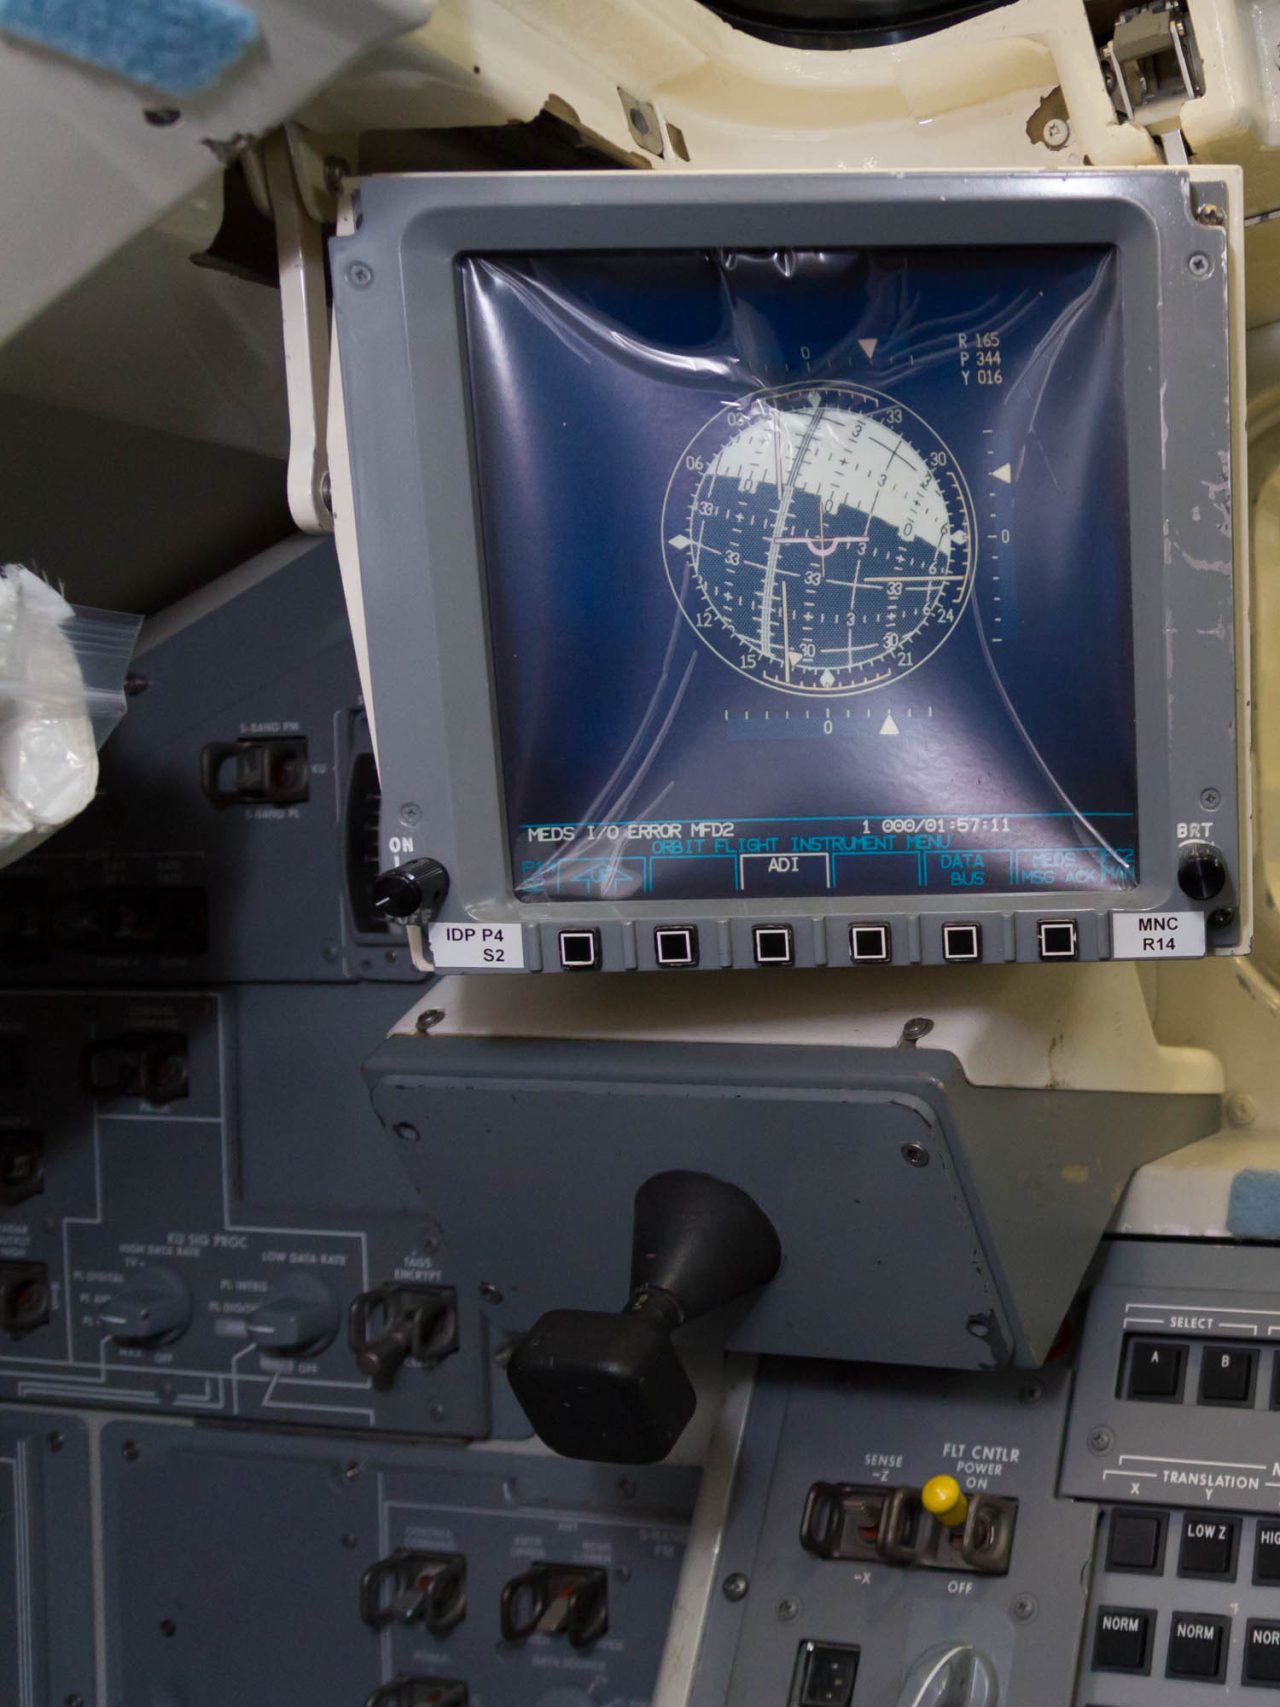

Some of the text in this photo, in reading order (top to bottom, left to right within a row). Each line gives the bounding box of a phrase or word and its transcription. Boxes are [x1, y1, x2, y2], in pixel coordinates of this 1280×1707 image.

[958, 333, 1000, 348] R 165
[960, 352, 1001, 367] P 344
[962, 370, 1003, 386] Y 016
[887, 409, 904, 424] 33
[686, 456, 704, 471] 06
[930, 452, 948, 467] 30
[1001, 529, 1010, 543] 0
[804, 571, 821, 586] 33
[696, 612, 712, 627] 12
[937, 607, 954, 624] 24
[740, 654, 757, 669] 15
[898, 651, 914, 667] 21
[823, 719, 833, 734] 0
[528, 822, 735, 842] MEDS I/O ERROR MFD2
[862, 820, 871, 834] 1
[1176, 822, 1214, 839] BRT
[388, 836, 414, 853] ON
[651, 833, 952, 855] ORBIT FLIGHT INSTRUMENT MENU
[768, 857, 799, 872] ADI
[940, 854, 984, 869] DATA
[950, 871, 984, 887] BUS
[1022, 869, 1056, 884] MSG
[1138, 917, 1179, 932] MNC
[446, 927, 504, 942] IDP P4
[1142, 937, 1176, 951] R14
[483, 948, 505, 962] S2
[1169, 1316, 1213, 1330] SELECT
[1150, 1350, 1160, 1364] A
[1221, 1354, 1230, 1368] B
[864, 1453, 904, 1469] SENSE
[942, 1443, 1020, 1464] FLT CNTLR
[956, 1460, 1003, 1476] POWER
[966, 1477, 988, 1490] ON
[1162, 1470, 1260, 1491] TRANSLATION
[1130, 1482, 1141, 1496] X
[1204, 1488, 1214, 1502] Y
[1187, 1523, 1227, 1540] LOW Z
[947, 1580, 974, 1595] OFF
[1102, 1615, 1140, 1633] NORM
[1176, 1622, 1215, 1640] NORM
